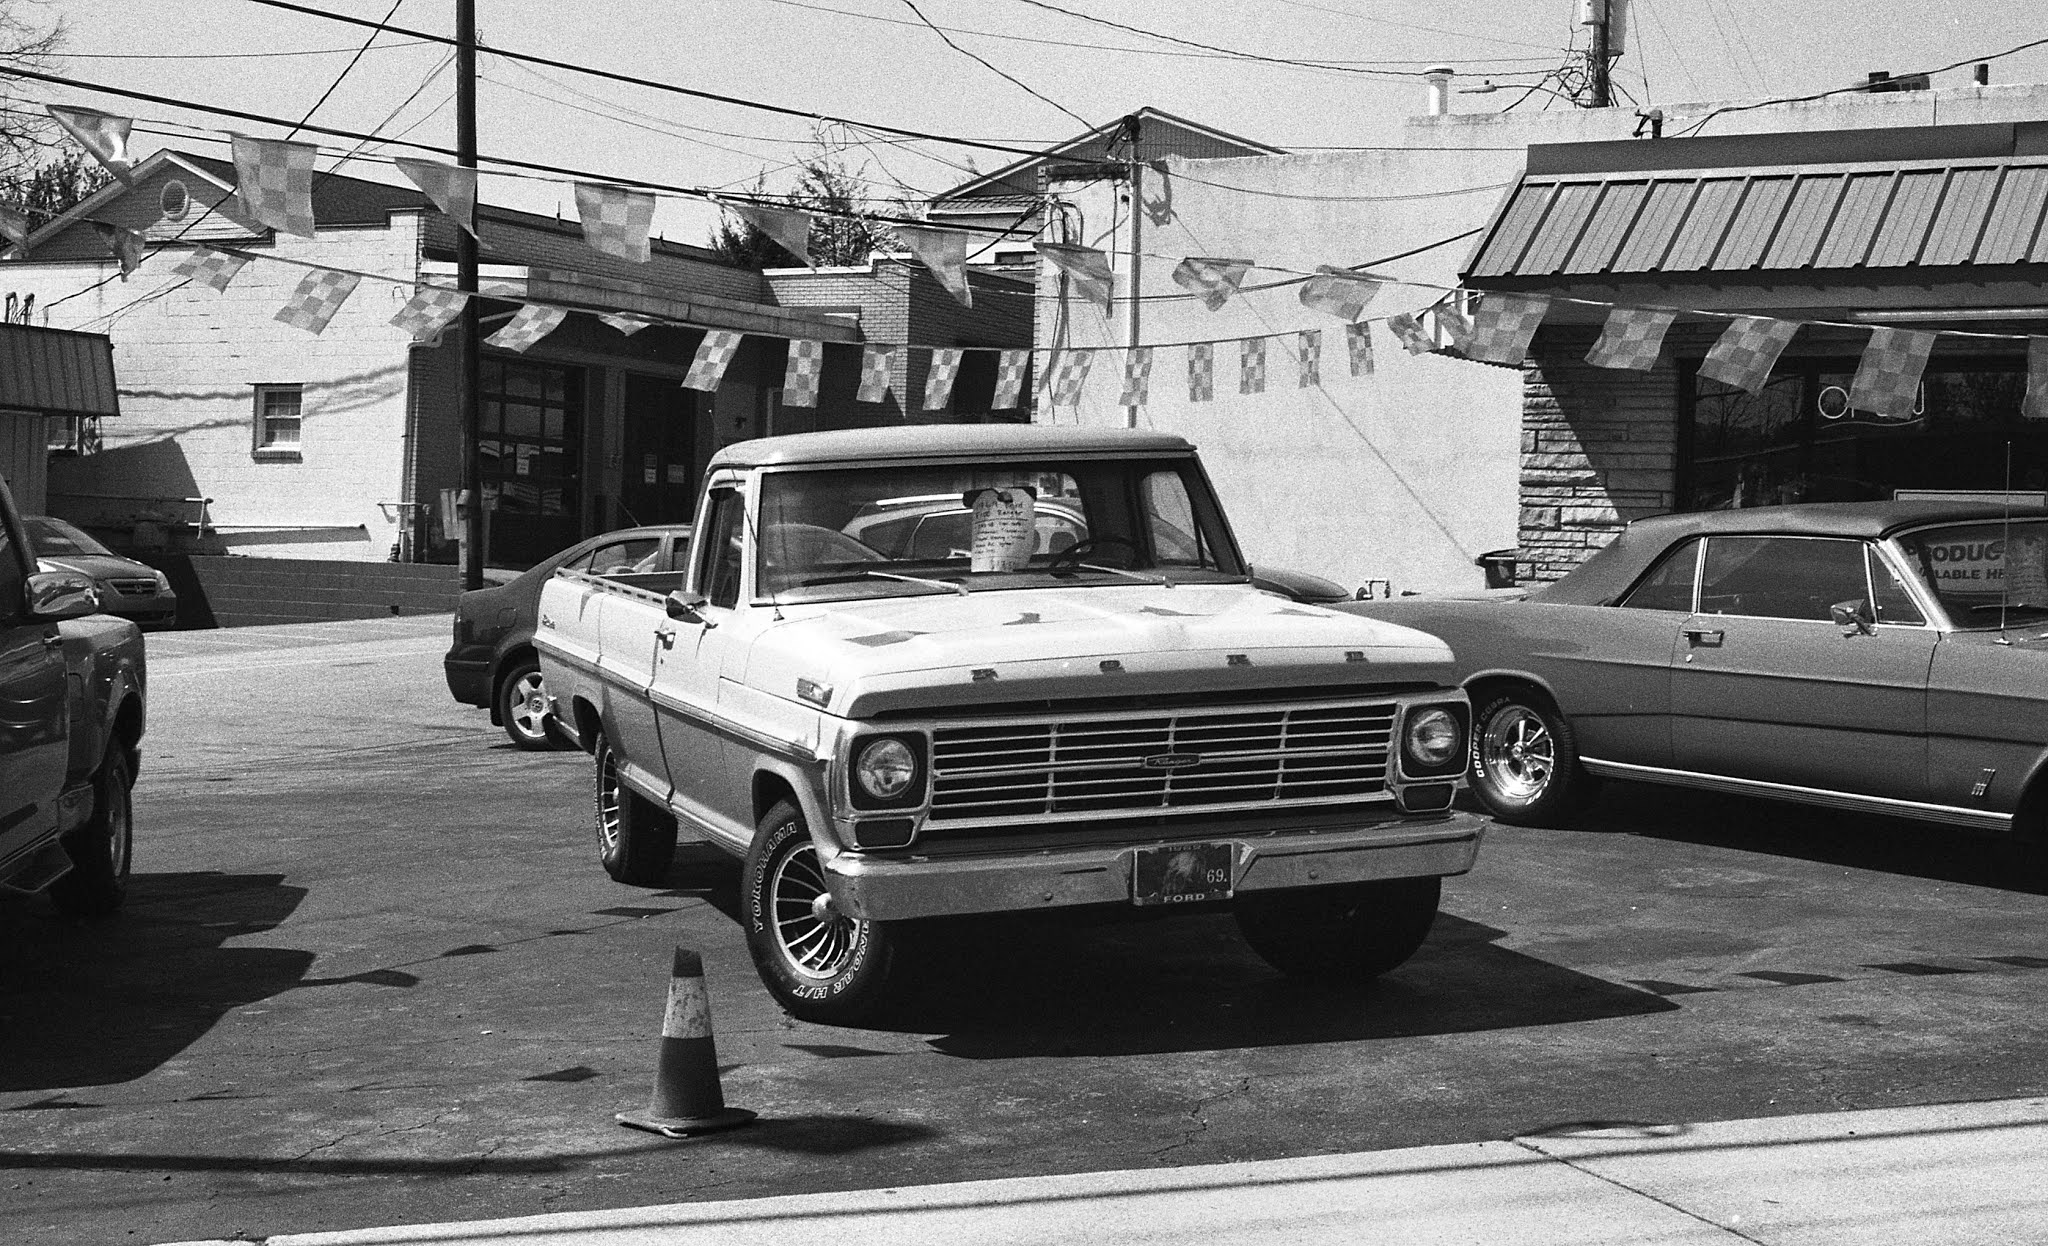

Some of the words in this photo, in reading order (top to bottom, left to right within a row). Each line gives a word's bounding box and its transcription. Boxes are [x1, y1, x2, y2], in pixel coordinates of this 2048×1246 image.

[1920, 567, 1980, 579] LABLE
[1473, 724, 1485, 778] COOPER
[752, 821, 797, 934] YOKOHAMA
[1163, 893, 1205, 903] FORD
[793, 984, 827, 999] H/T
